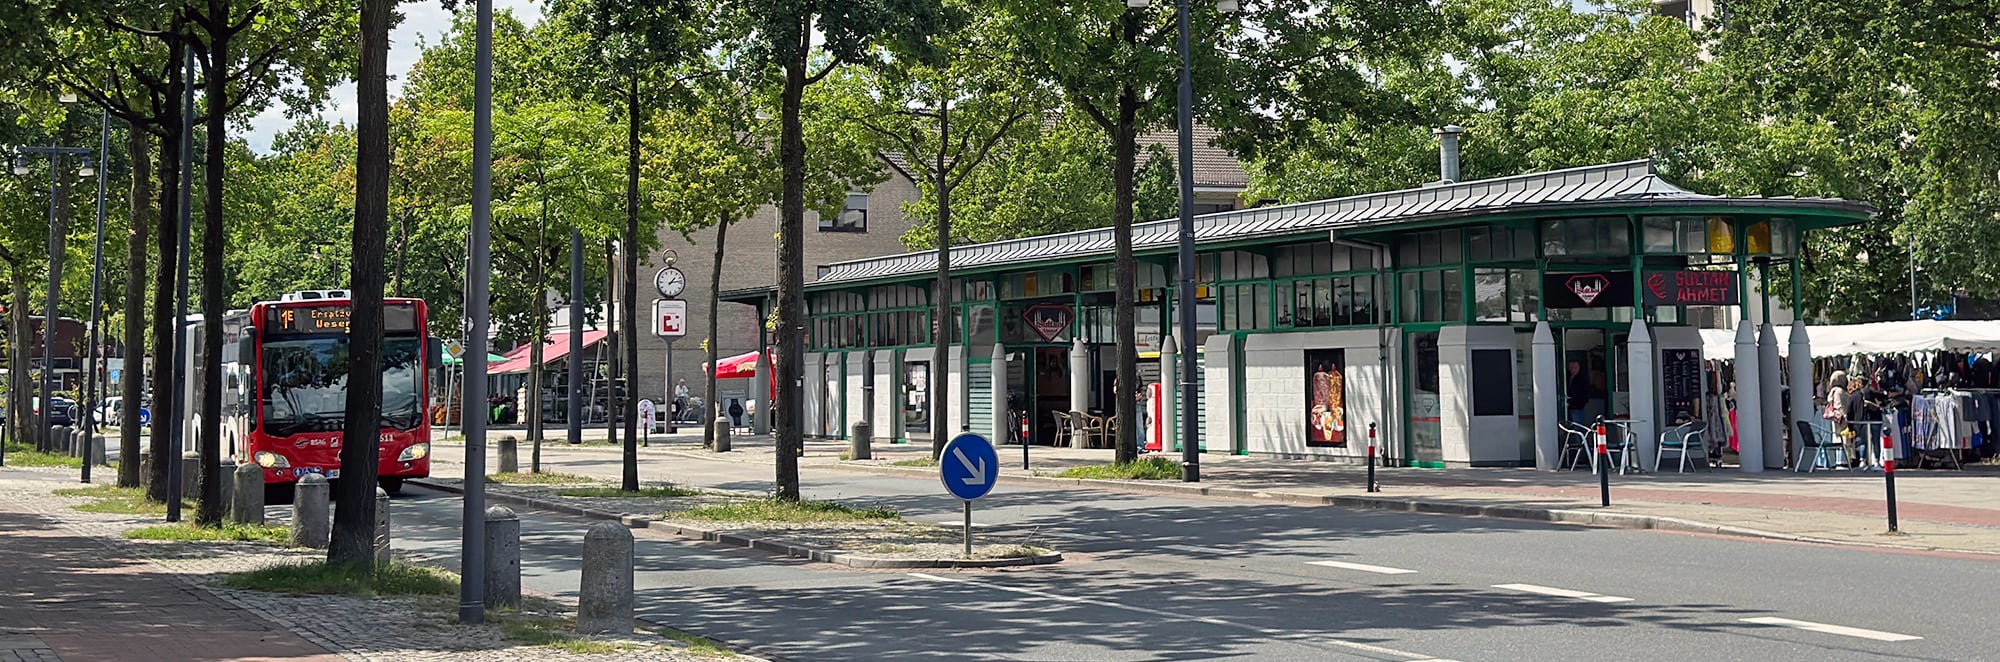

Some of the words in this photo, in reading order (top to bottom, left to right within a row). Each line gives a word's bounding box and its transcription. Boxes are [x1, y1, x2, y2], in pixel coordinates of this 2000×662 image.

[1675, 271, 1730, 287] SULTAN
[1677, 288, 1728, 302] AHMET
[281, 310, 295, 329] 1E
